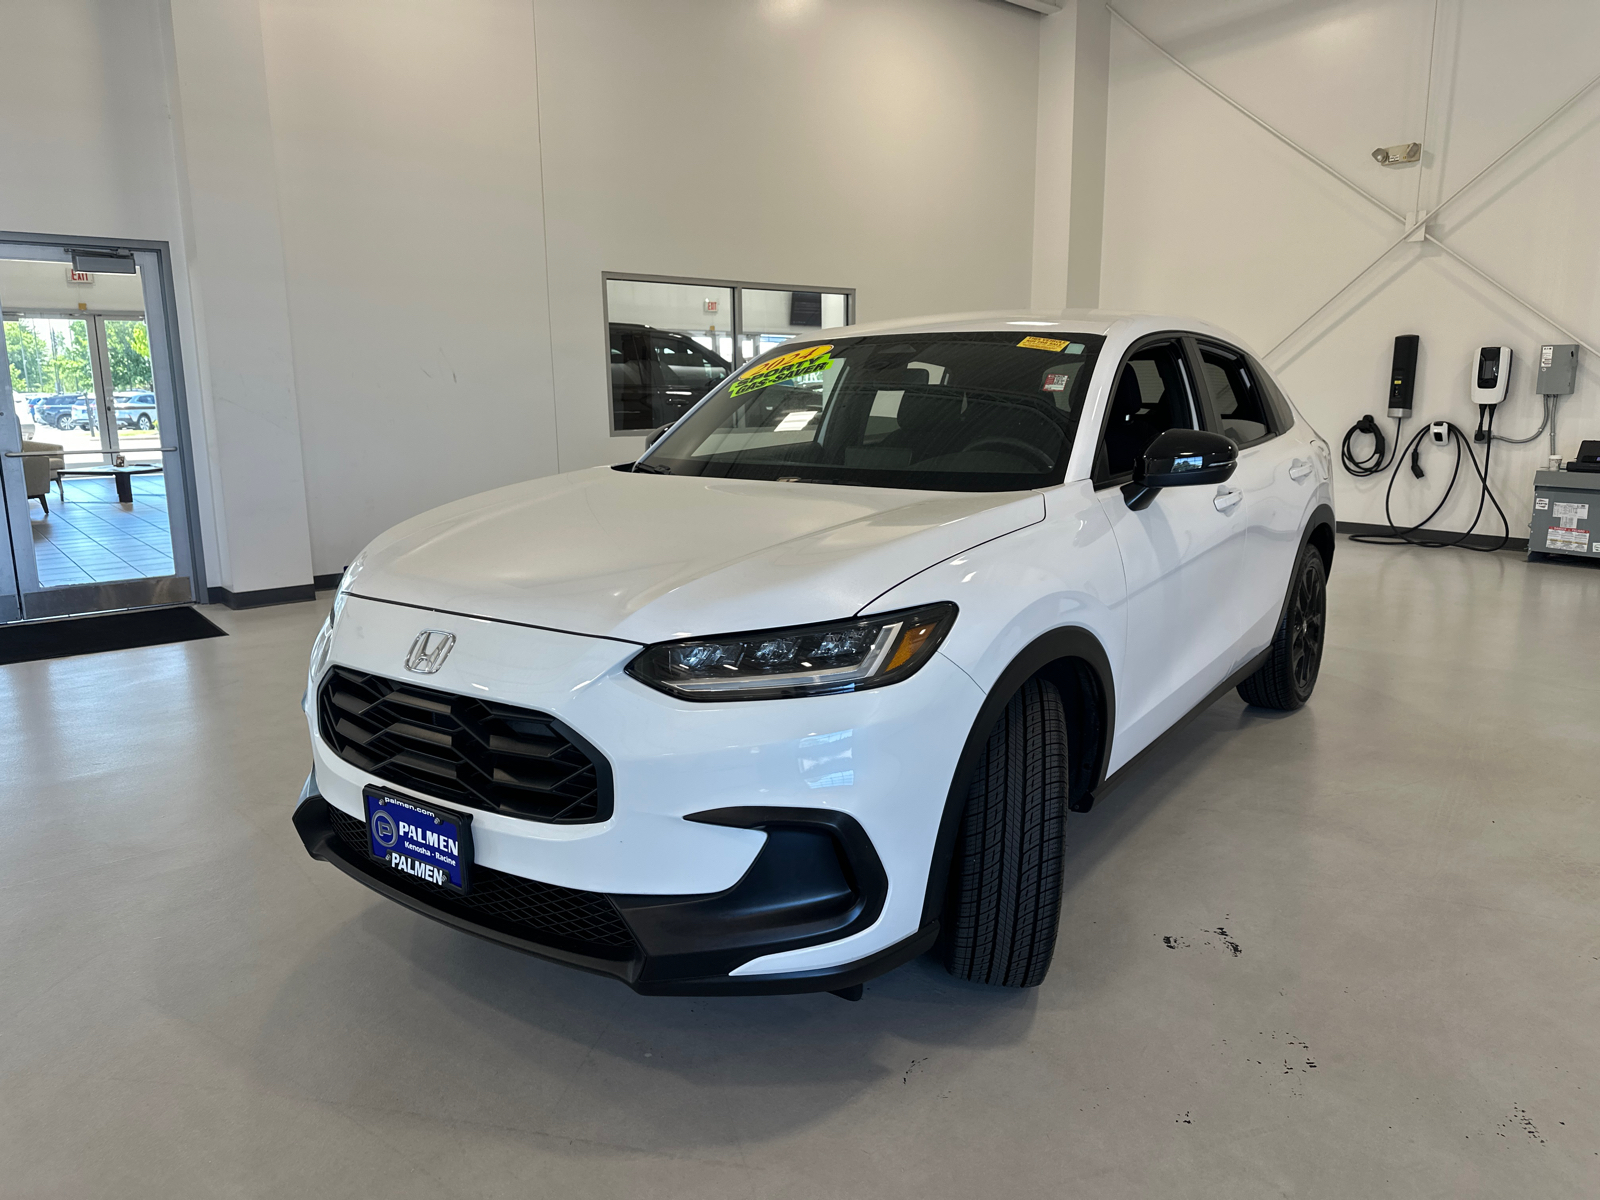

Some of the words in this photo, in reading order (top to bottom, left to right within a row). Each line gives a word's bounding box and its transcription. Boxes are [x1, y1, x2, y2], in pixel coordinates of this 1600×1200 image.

[735, 355, 825, 389] SPORTY
[384, 796, 435, 818] palmen.com
[399, 821, 459, 856] PALMEN
[404, 840, 431, 857] Kenosha
[435, 852, 456, 867] Racine
[391, 852, 443, 885] PALMEN
